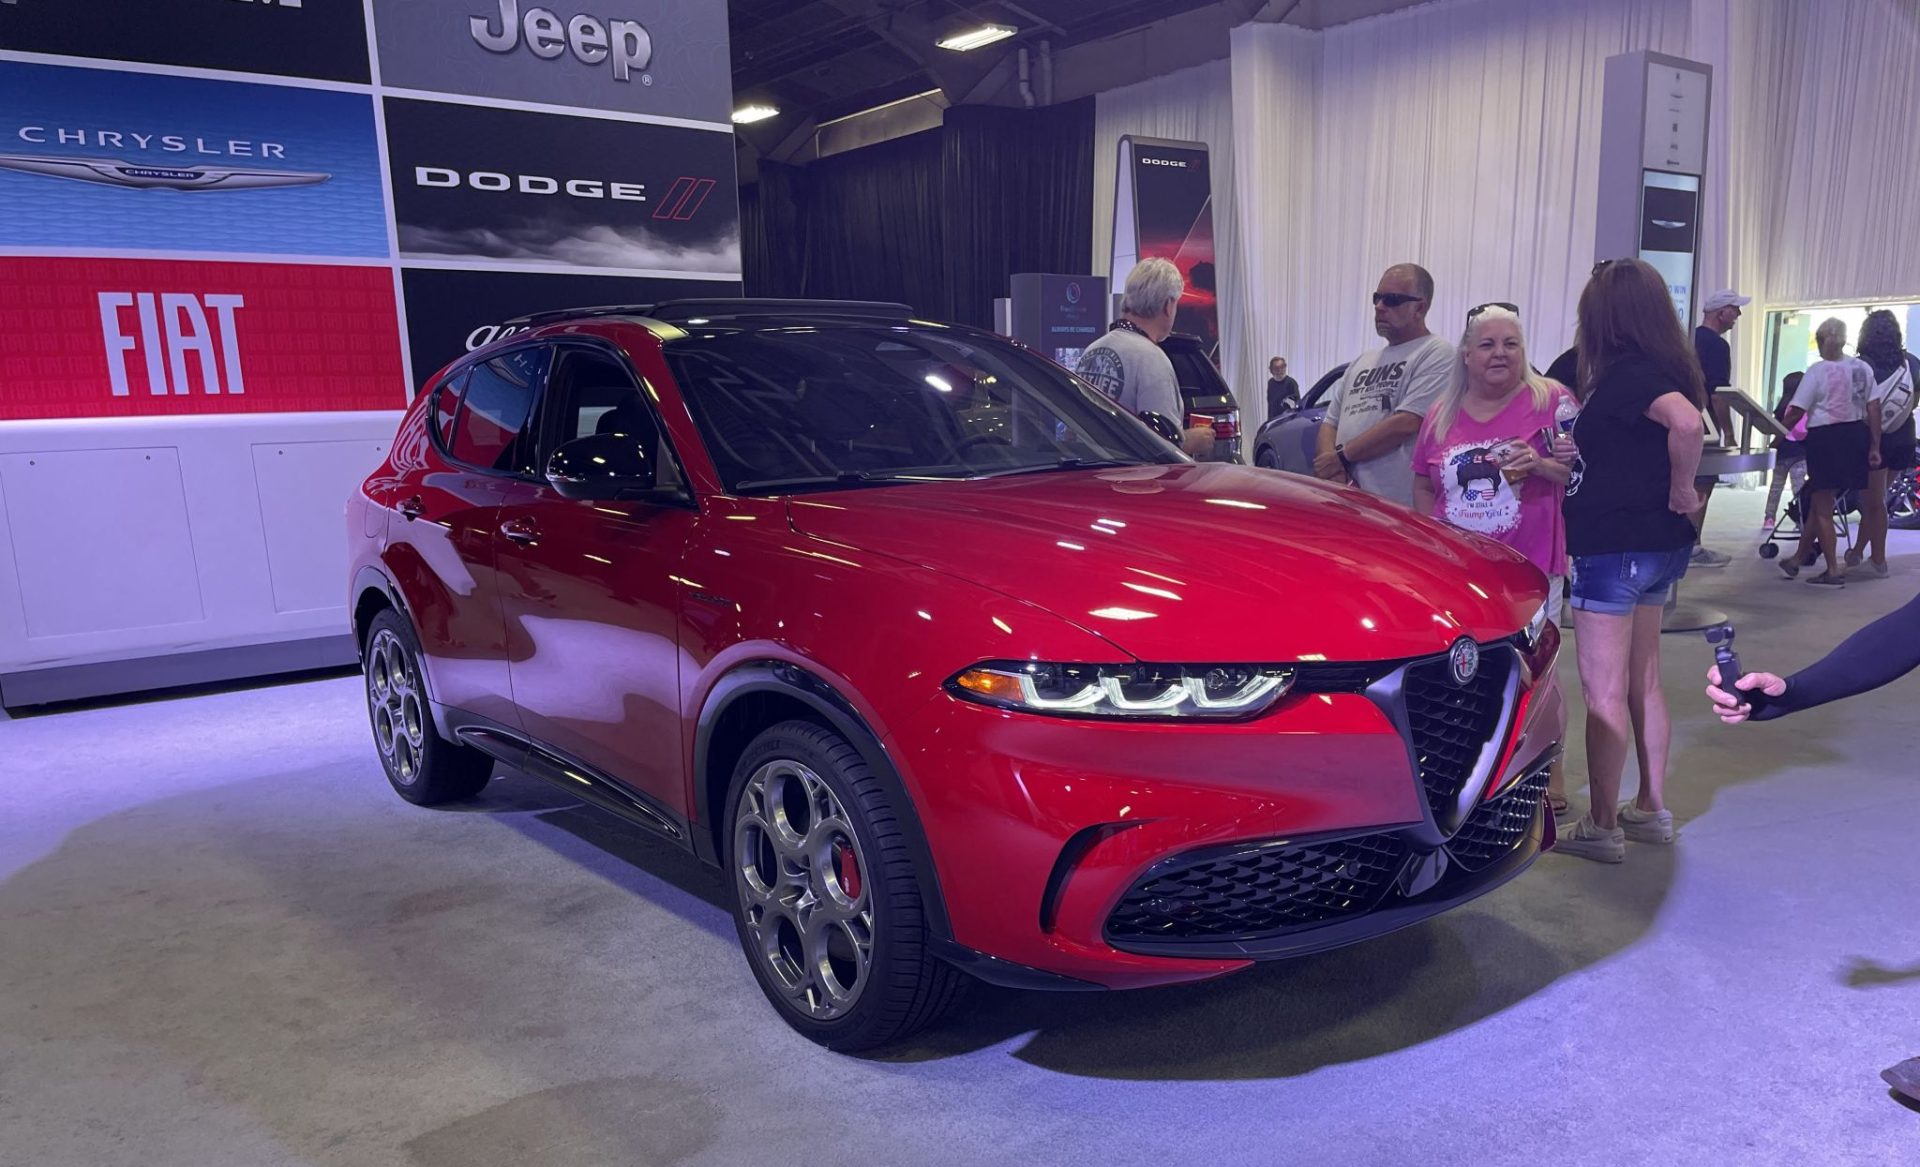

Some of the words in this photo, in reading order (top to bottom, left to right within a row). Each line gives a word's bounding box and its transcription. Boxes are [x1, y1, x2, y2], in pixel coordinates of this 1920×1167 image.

[468, 0, 652, 82] Jeep
[18, 126, 287, 160] CHRYSLER
[124, 168, 195, 179] CHRYSLER
[1142, 157, 1187, 168] DODGE
[415, 166, 646, 201] DODGE
[97, 290, 246, 397] FIAT
[1352, 360, 1407, 388] GUNS
[1375, 381, 1399, 389] PEOPLE
